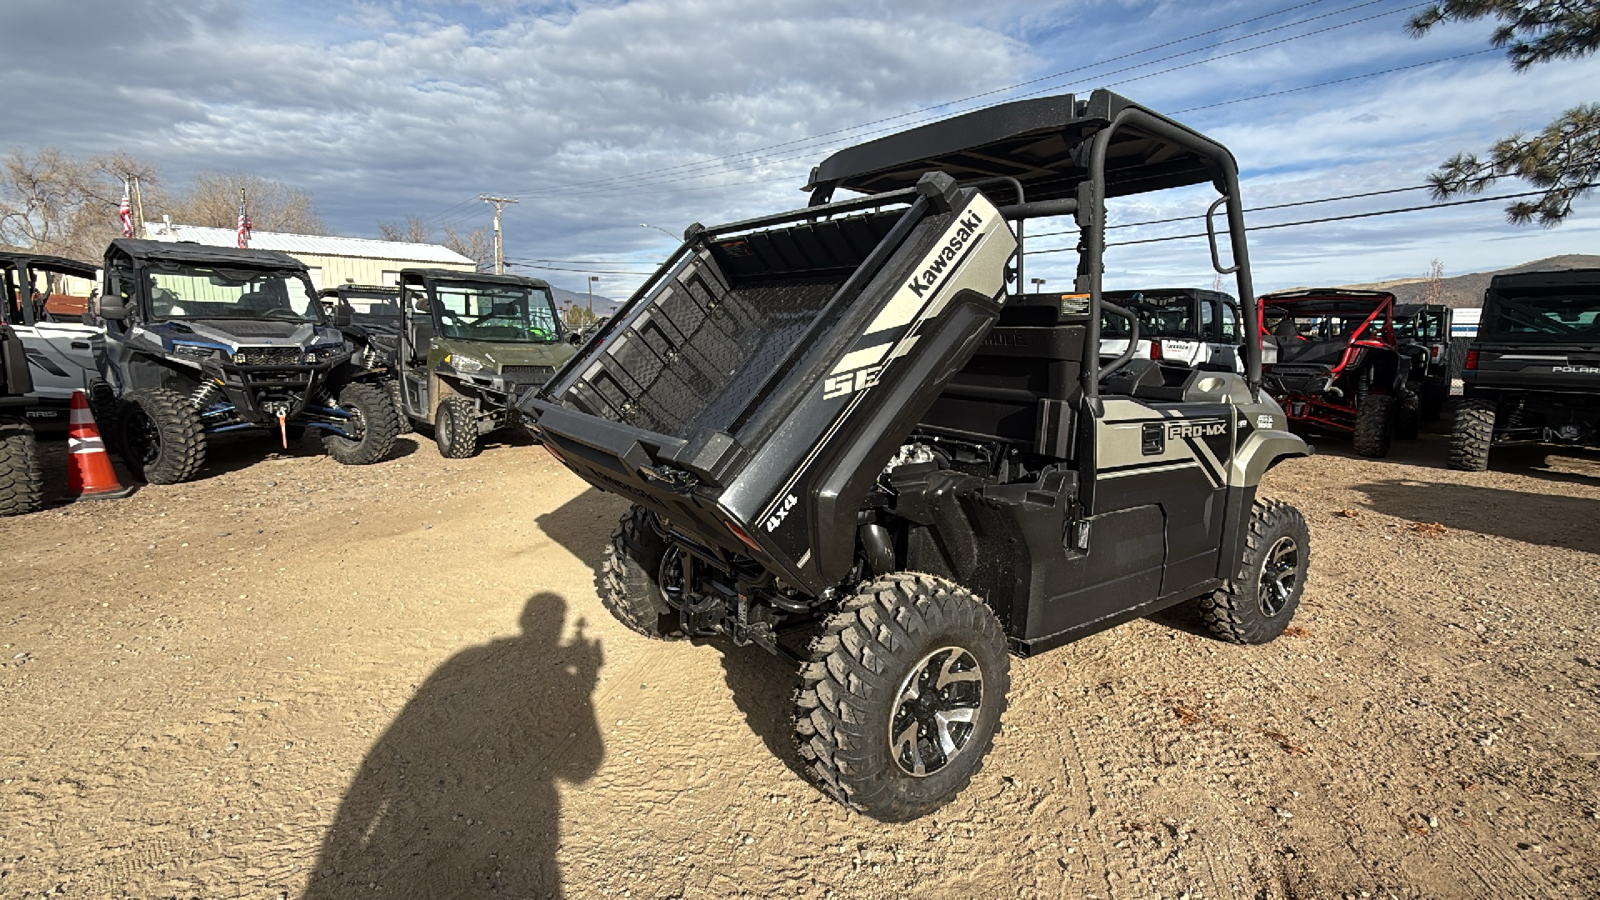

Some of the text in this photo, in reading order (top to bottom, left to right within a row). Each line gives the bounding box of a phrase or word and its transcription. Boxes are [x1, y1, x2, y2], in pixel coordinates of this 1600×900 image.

[908, 209, 983, 299] Kawasaki
[823, 365, 882, 400] SE
[1169, 423, 1227, 440] PRO-MX
[766, 494, 798, 532] 4x4
